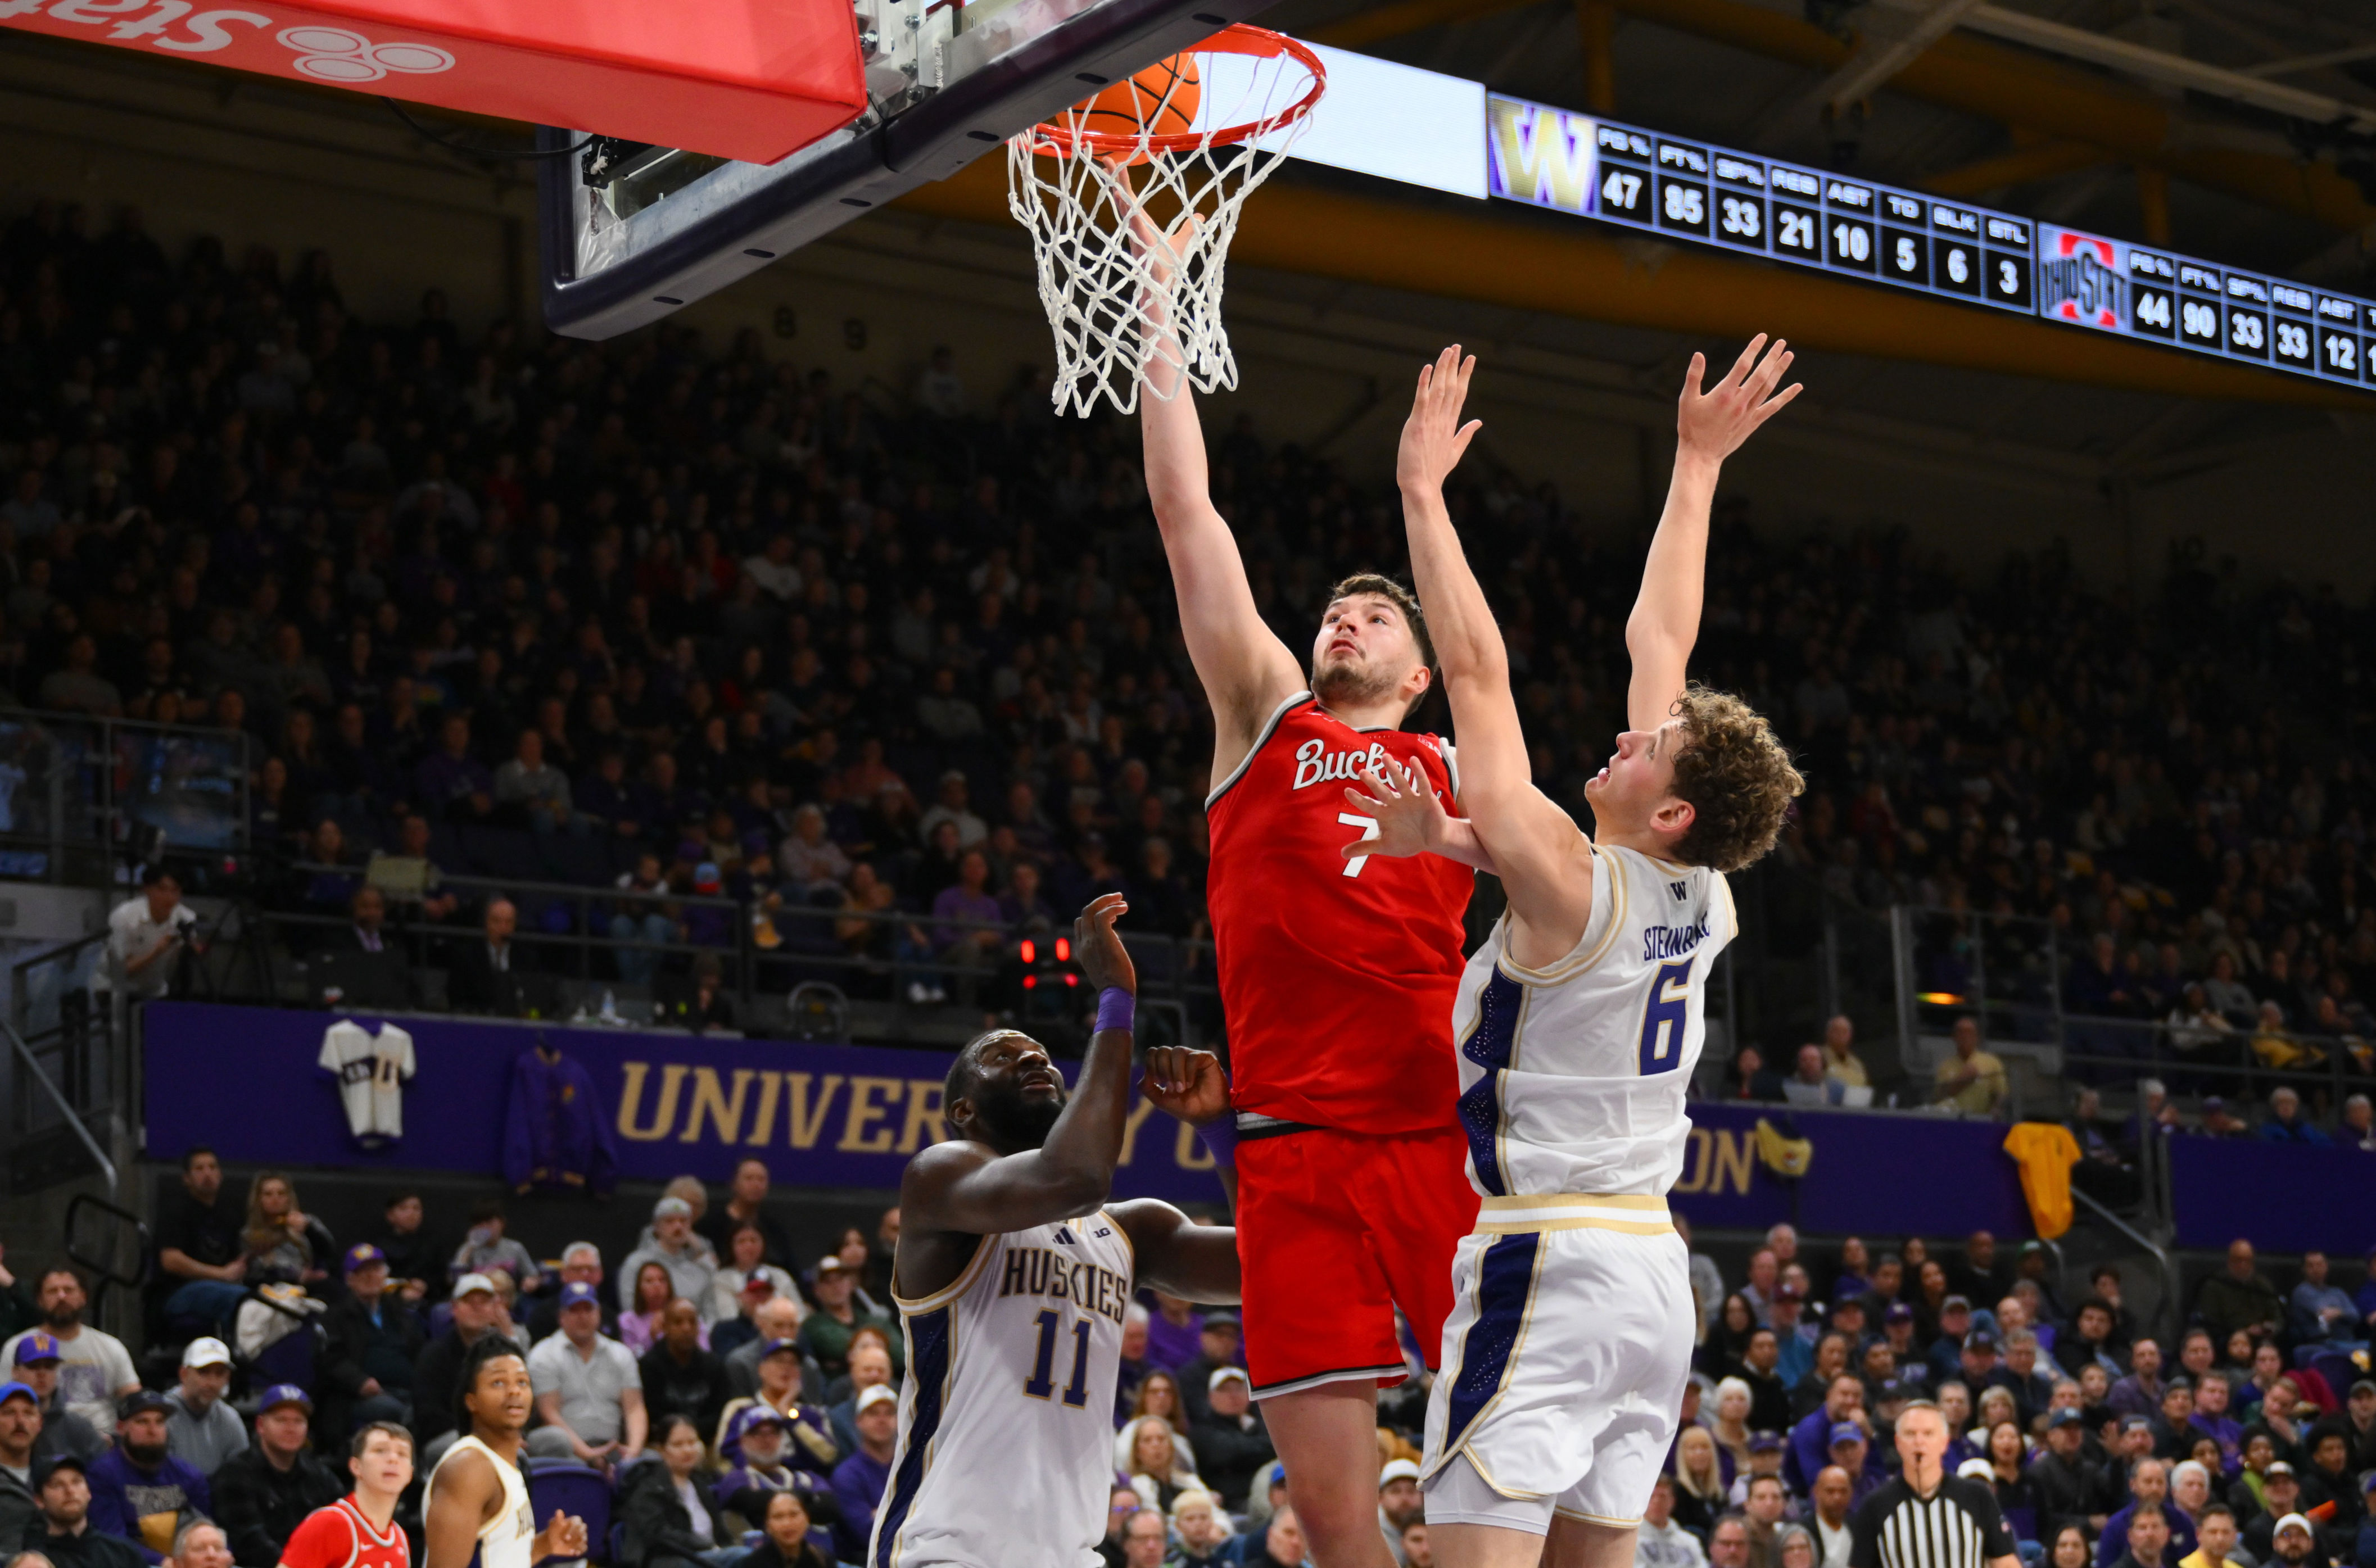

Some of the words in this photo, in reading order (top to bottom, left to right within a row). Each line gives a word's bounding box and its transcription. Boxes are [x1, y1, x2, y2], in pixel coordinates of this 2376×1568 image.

[1602, 171, 1642, 210] 47
[1664, 184, 1704, 224] 85
[1722, 198, 1760, 237] 33
[1778, 211, 1814, 250] 21
[1834, 224, 1870, 261] 10
[1897, 237, 1917, 272] 5
[1947, 249, 1968, 283] 6
[1999, 260, 2019, 294] 3
[1988, 219, 2028, 244] STL
[2137, 291, 2171, 328] 44
[2232, 312, 2264, 349] 33
[2277, 323, 2309, 359] 33
[2325, 335, 2356, 370] 12
[1338, 812, 1379, 878] 7
[1670, 881, 1686, 900] W
[1637, 954, 1698, 1076] 6
[999, 1247, 1126, 1325] HUSKIES
[1022, 1307, 1093, 1410] 11
